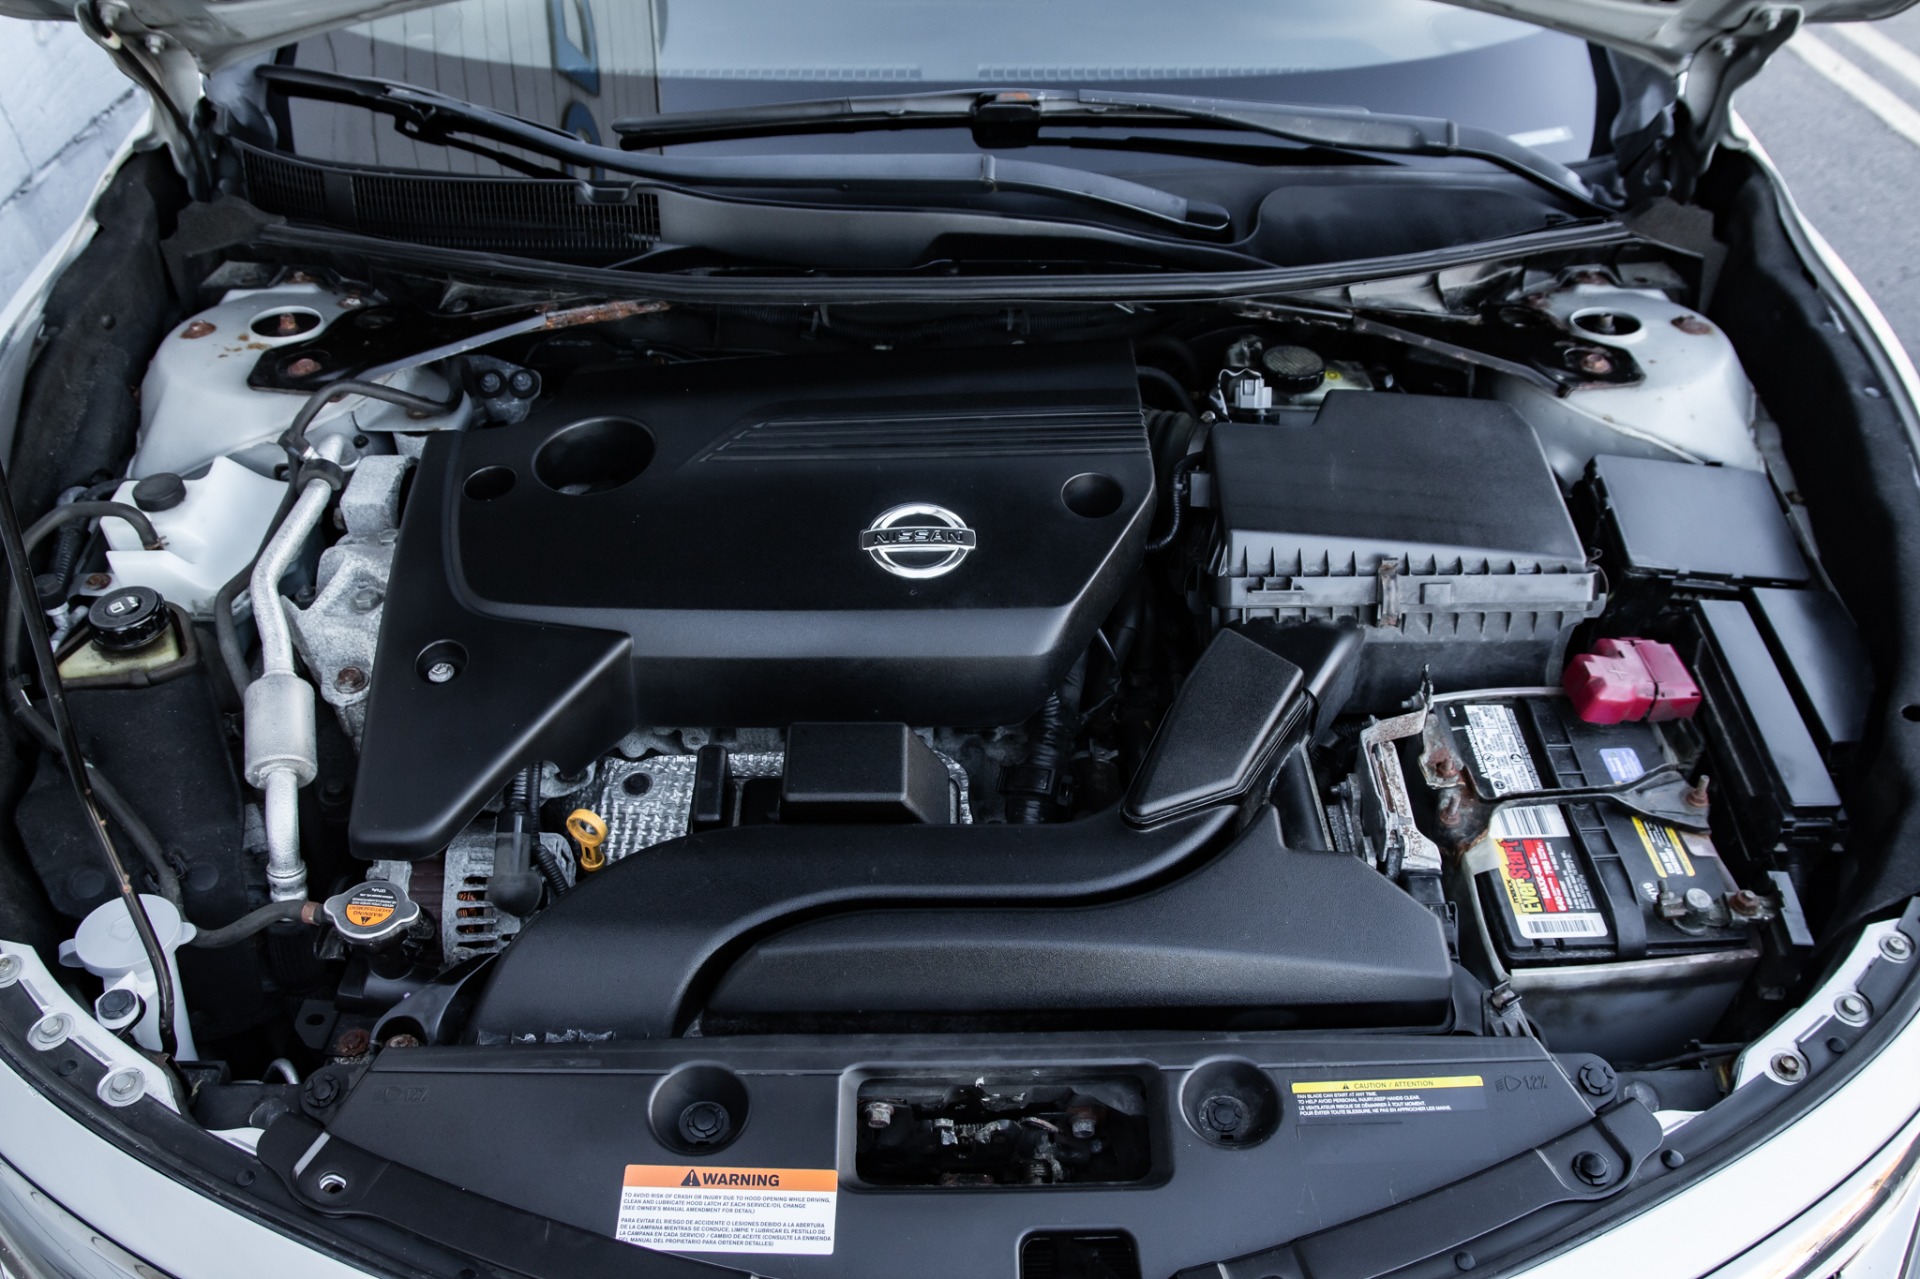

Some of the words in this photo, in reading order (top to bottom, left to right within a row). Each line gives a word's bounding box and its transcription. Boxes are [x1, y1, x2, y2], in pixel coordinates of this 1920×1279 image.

[874, 530, 964, 544] NISSAN
[1497, 840, 1543, 912] EverStart
[1522, 1075, 1549, 1091] 1.2%
[703, 1173, 779, 1186] WARNING
